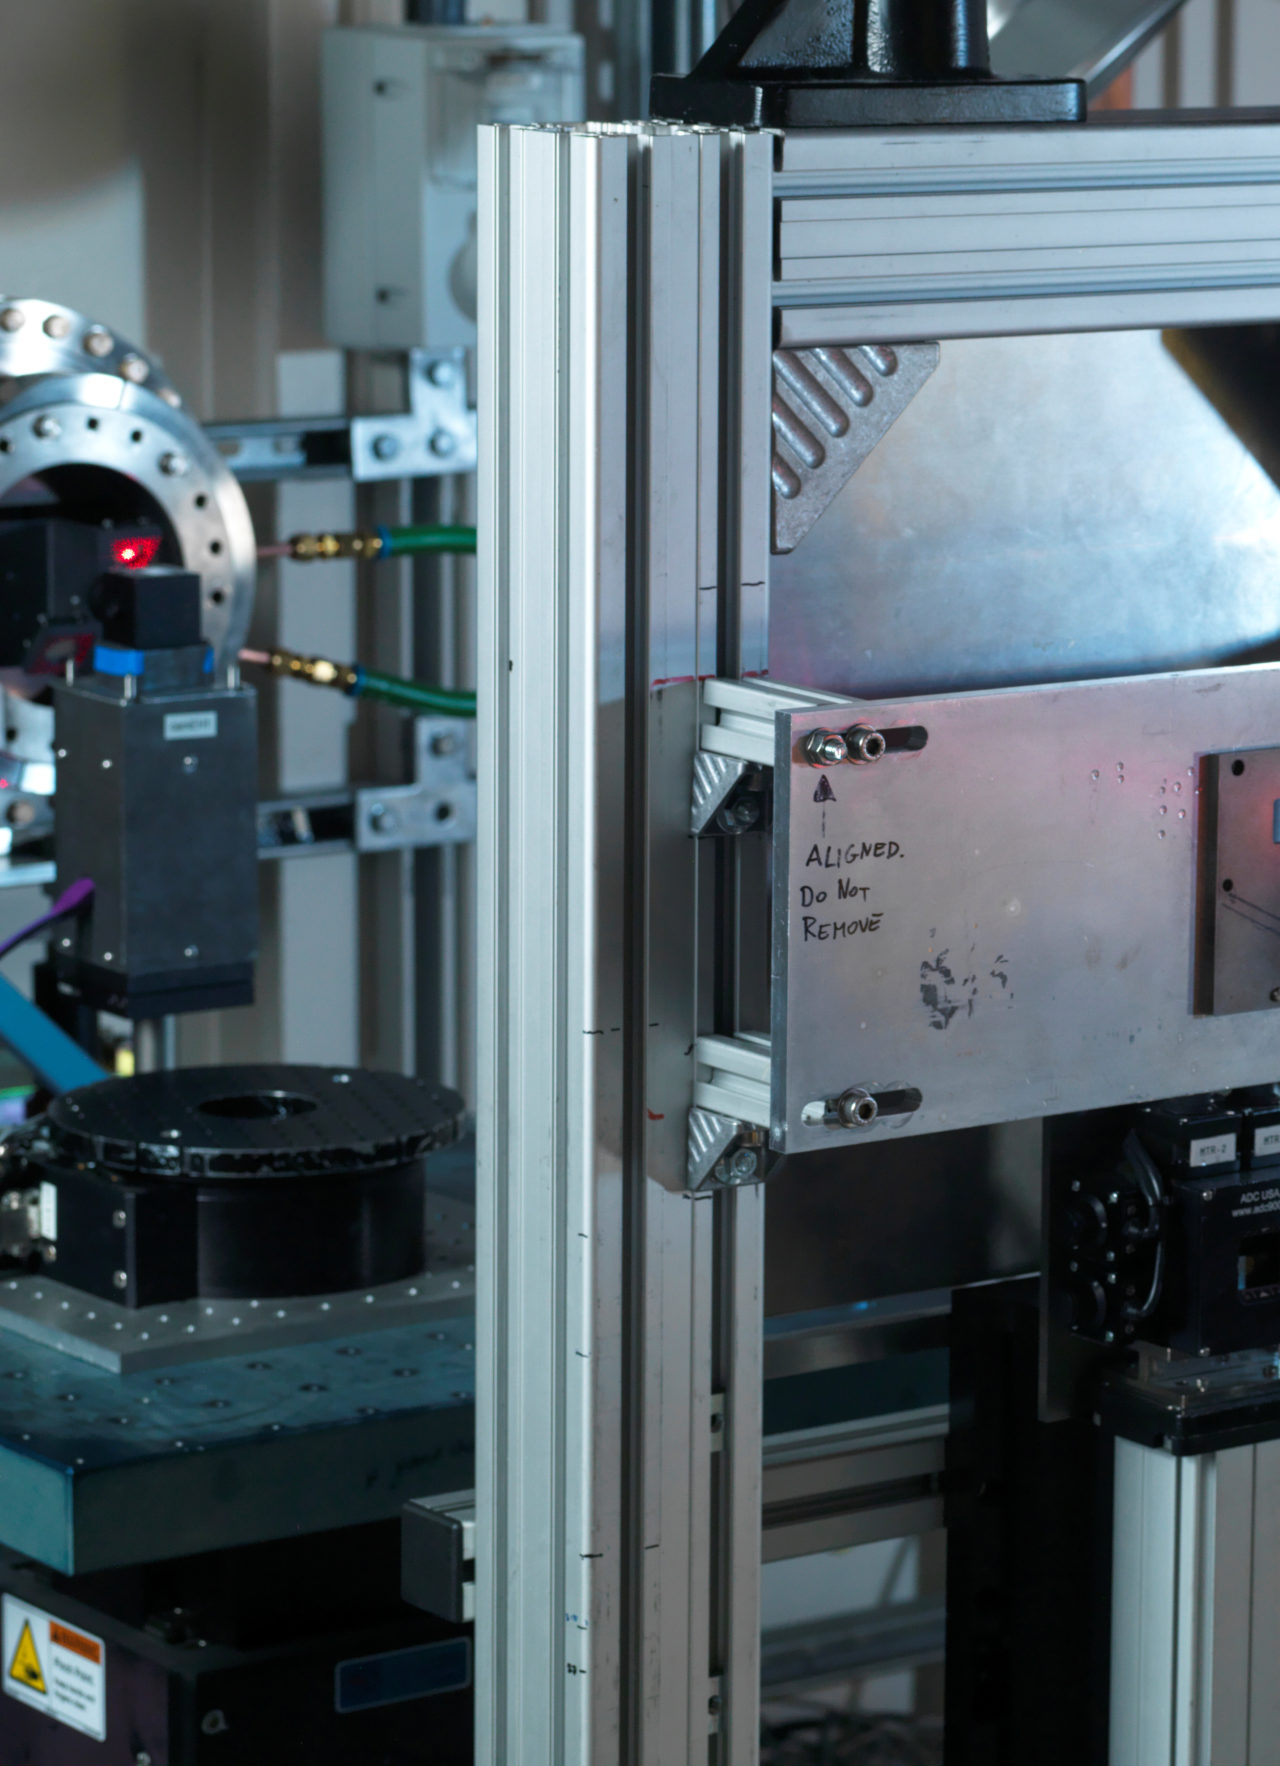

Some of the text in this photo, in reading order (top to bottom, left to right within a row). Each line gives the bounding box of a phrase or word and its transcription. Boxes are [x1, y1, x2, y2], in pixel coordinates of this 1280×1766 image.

[805, 840, 905, 869] ALIGNED.
[802, 912, 884, 942] REMOVE
[1199, 1143, 1228, 1157] MTR-2
[1240, 1191, 1260, 1204] ADC
